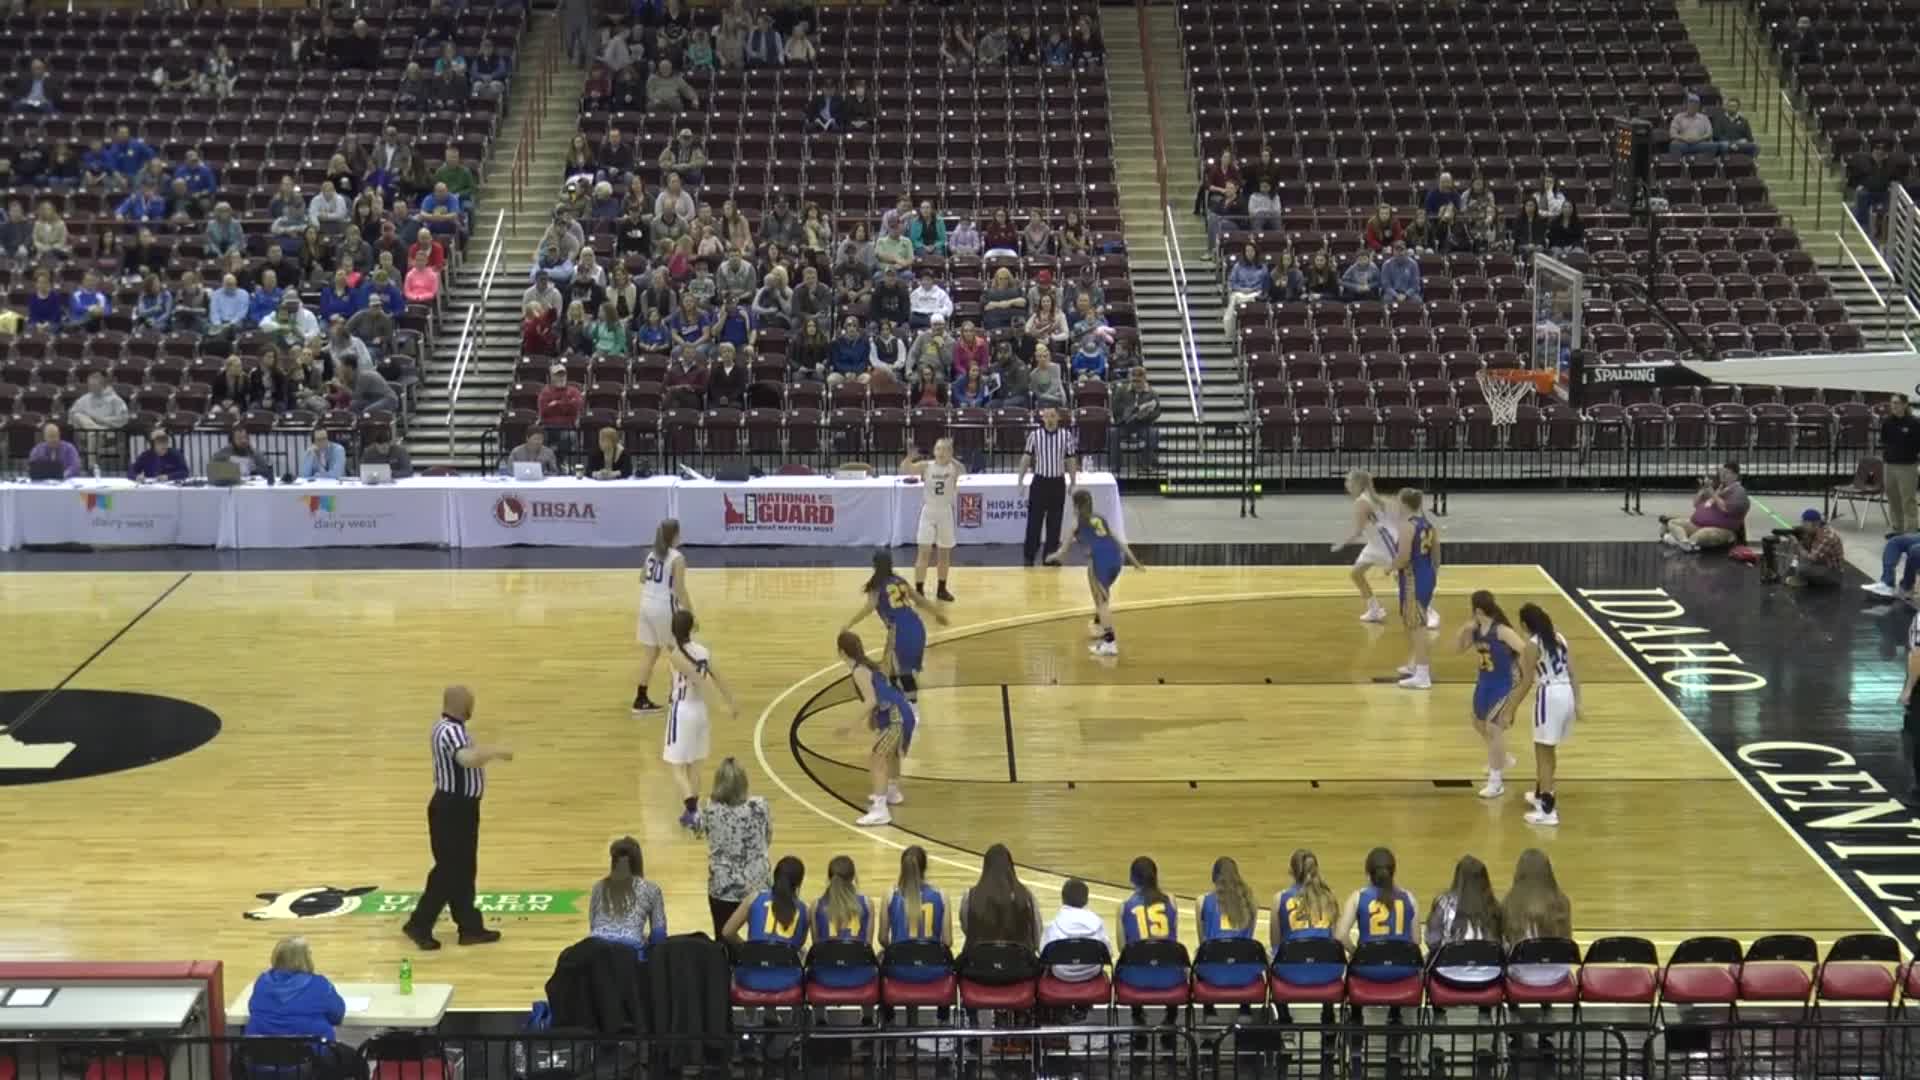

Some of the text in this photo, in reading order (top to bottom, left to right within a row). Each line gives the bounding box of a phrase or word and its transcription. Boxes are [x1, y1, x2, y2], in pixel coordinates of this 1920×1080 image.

[1594, 367, 1655, 383] SPALDING
[935, 481, 945, 495] 2
[758, 493, 817, 504] NATIONAL
[986, 501, 1014, 510] HIGH
[531, 502, 596, 519] IHSAA
[758, 504, 834, 524] GUARD
[986, 511, 1028, 520] HAPPEN
[313, 518, 377, 533] dairy west
[646, 558, 665, 583] 30
[1576, 587, 1768, 692] IDAHO
[1737, 740, 1920, 942] CENT
[383, 894, 553, 904] UTED
[1131, 903, 1169, 937] 15
[1368, 899, 1405, 936] 21
